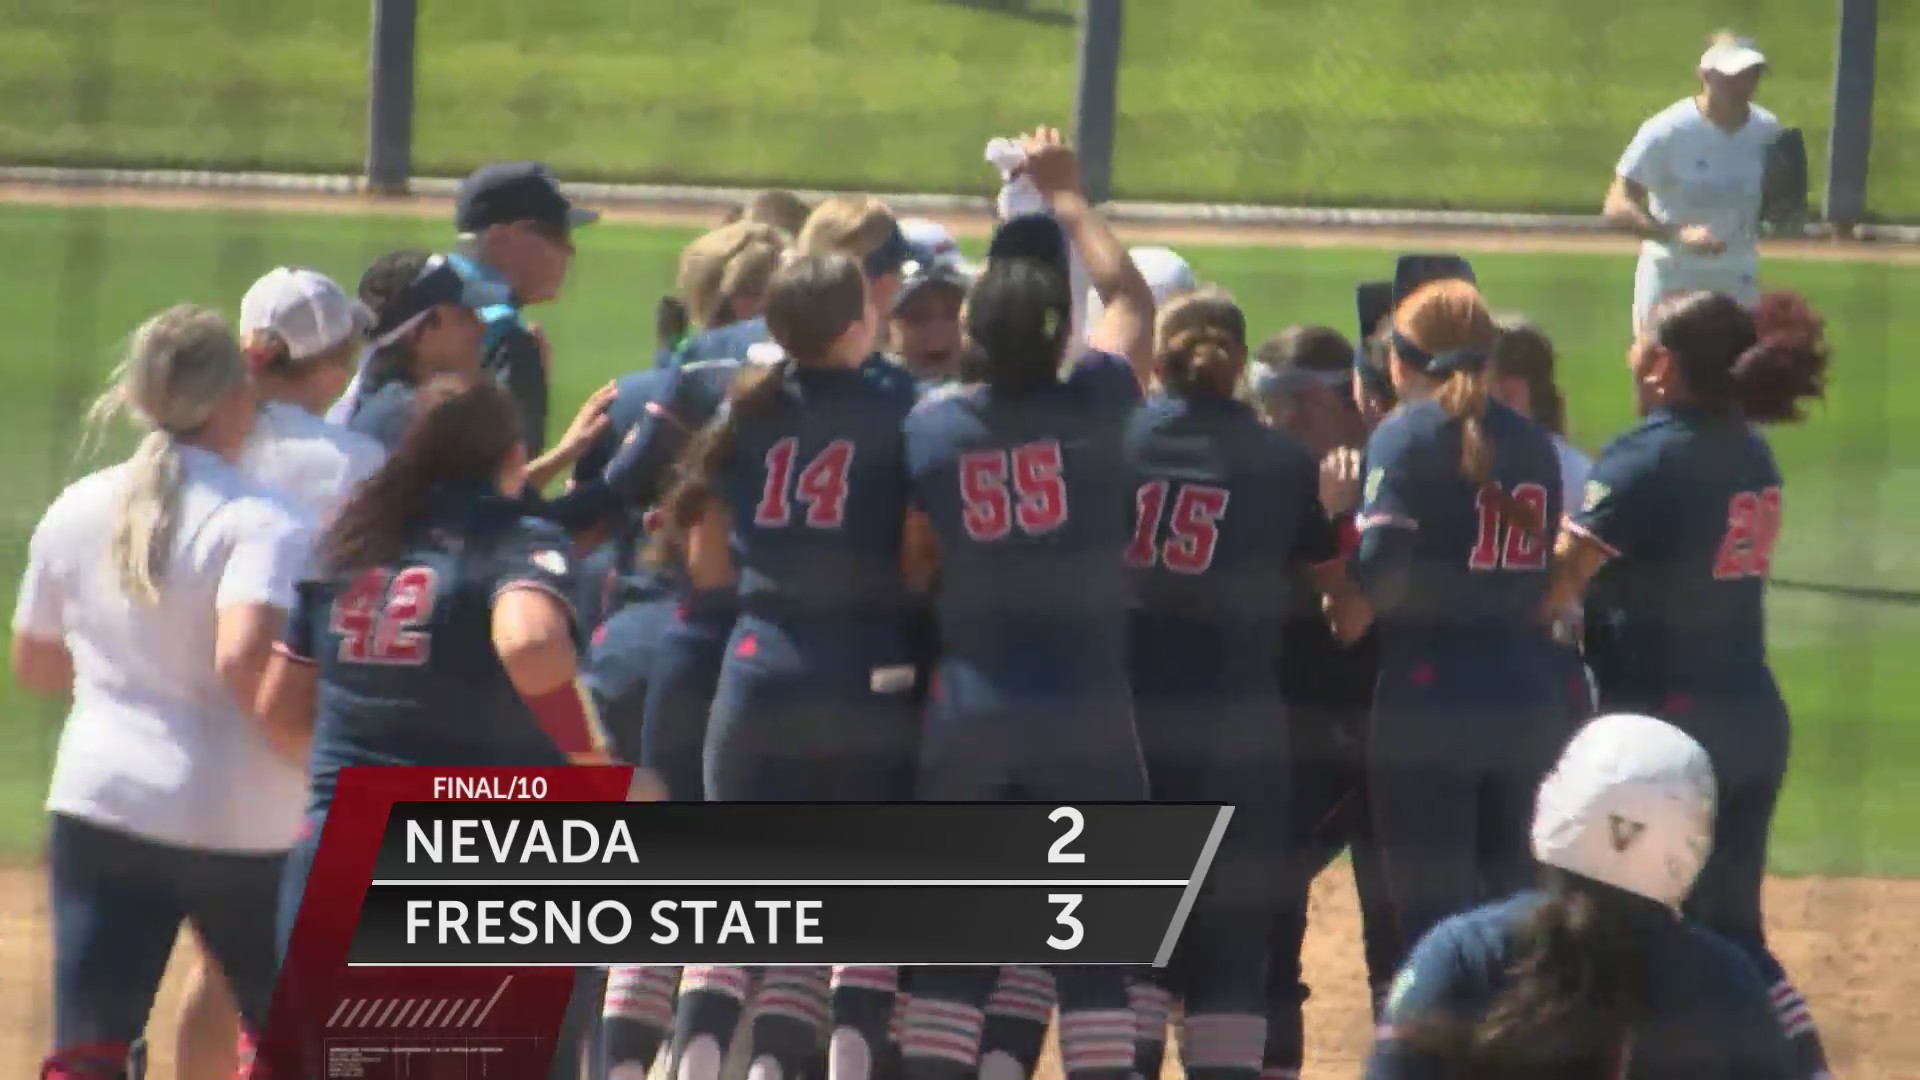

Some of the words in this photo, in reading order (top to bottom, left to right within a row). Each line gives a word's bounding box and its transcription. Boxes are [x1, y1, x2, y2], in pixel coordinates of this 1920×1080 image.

[754, 437, 855, 528] 14
[959, 442, 1068, 541] 55
[1125, 480, 1229, 574] 15
[329, 566, 438, 665] 42
